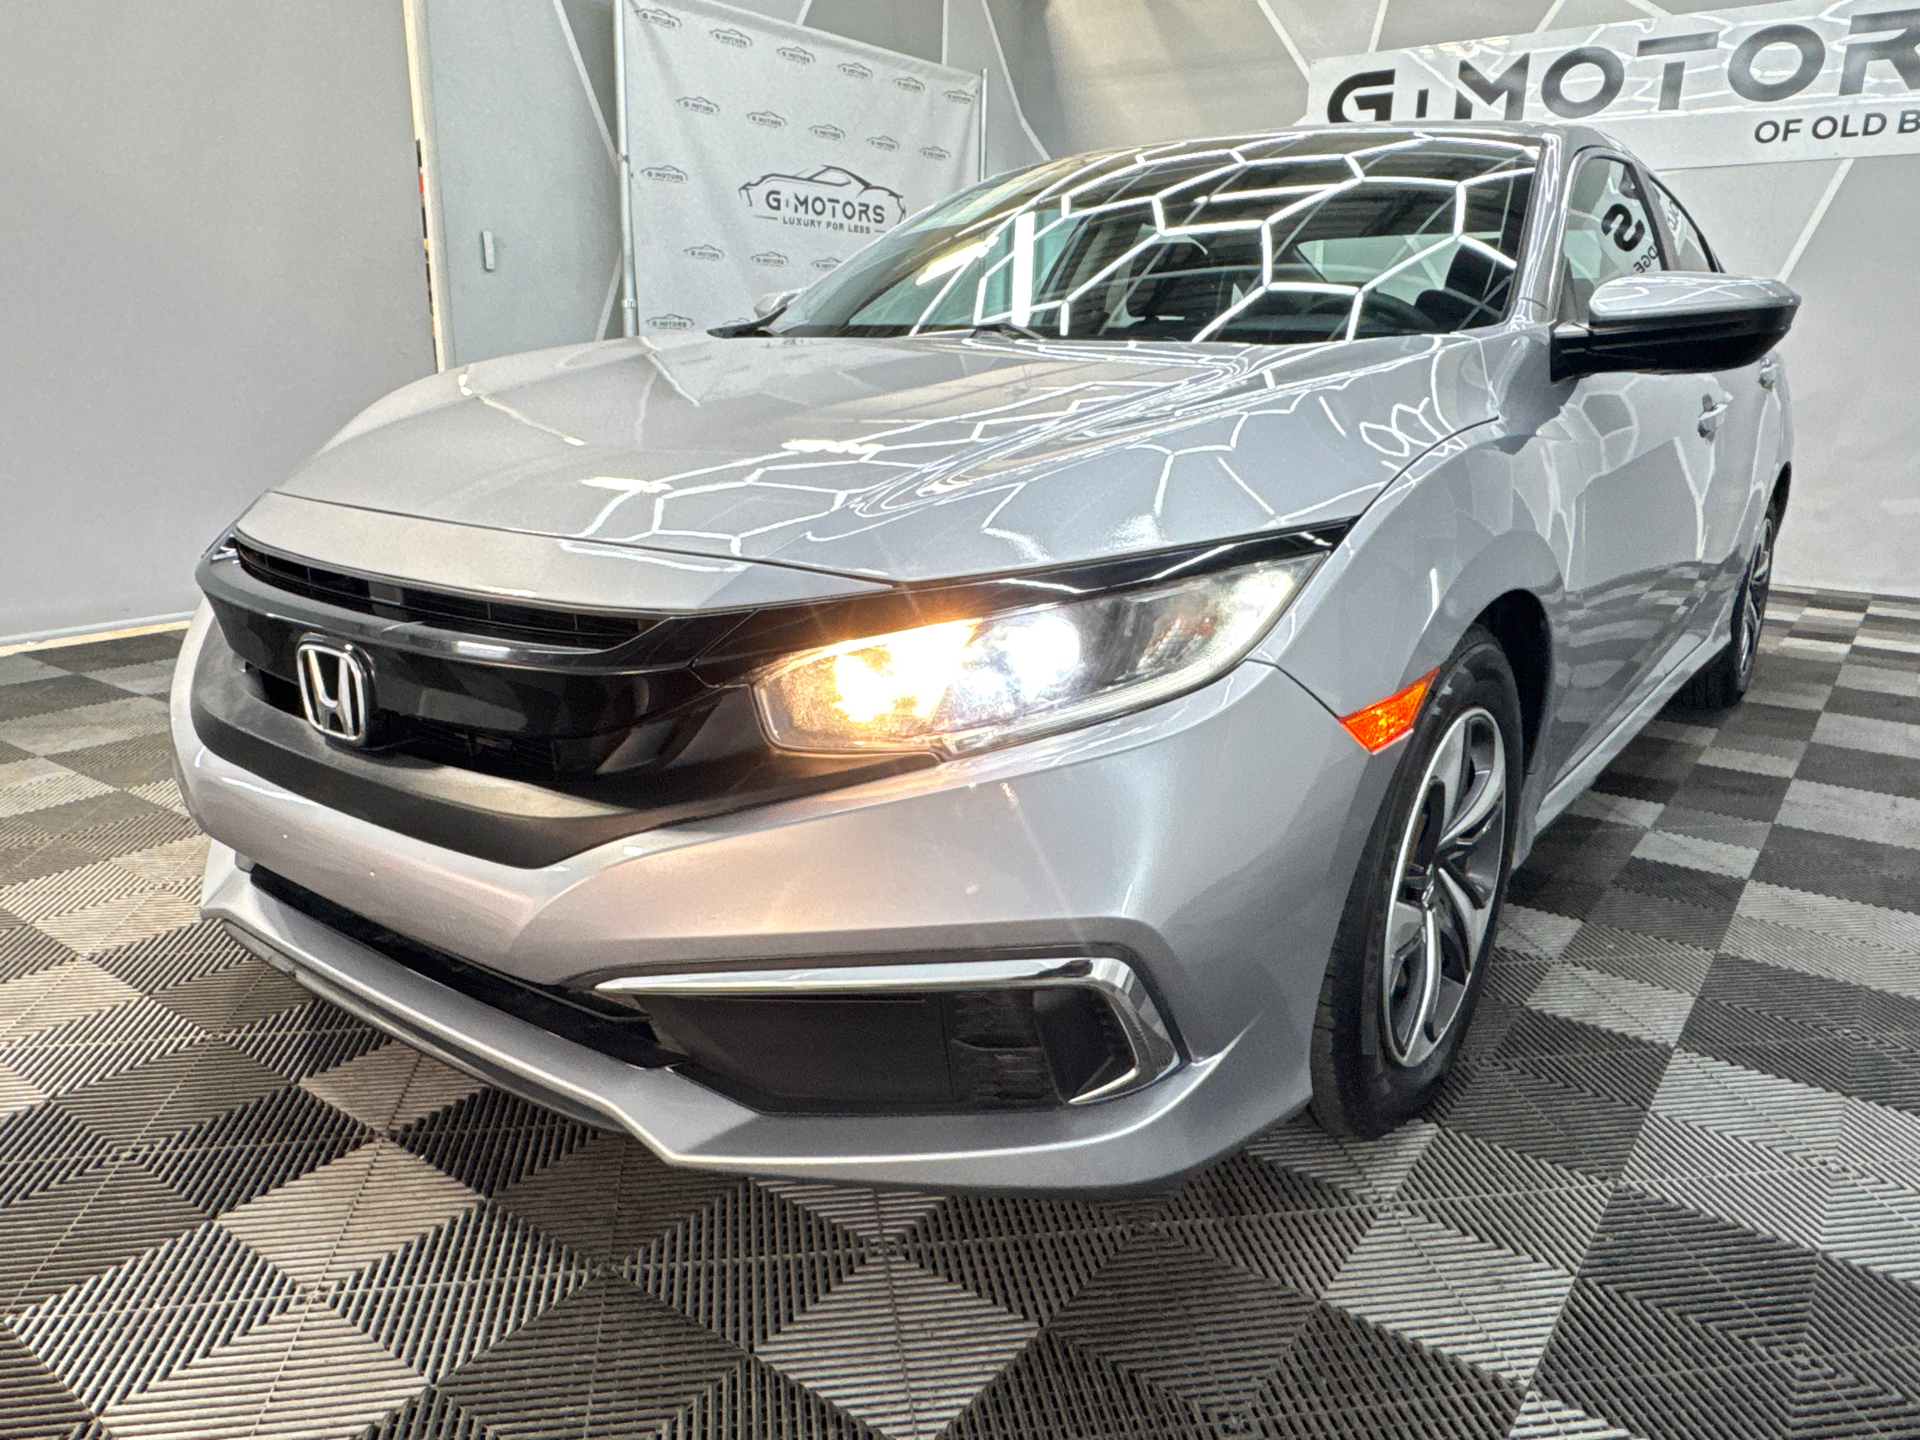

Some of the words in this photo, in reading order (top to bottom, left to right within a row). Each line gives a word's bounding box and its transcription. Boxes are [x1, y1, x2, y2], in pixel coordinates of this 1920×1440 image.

[1327, 69, 1396, 123] G
[1754, 118, 1803, 144] OF
[1811, 112, 1888, 140] OLD
[765, 190, 782, 211] G
[793, 192, 886, 224] MOTORS
[782, 215, 822, 229] LUXURY
[826, 221, 845, 232] FOR
[848, 224, 871, 235] LESS
